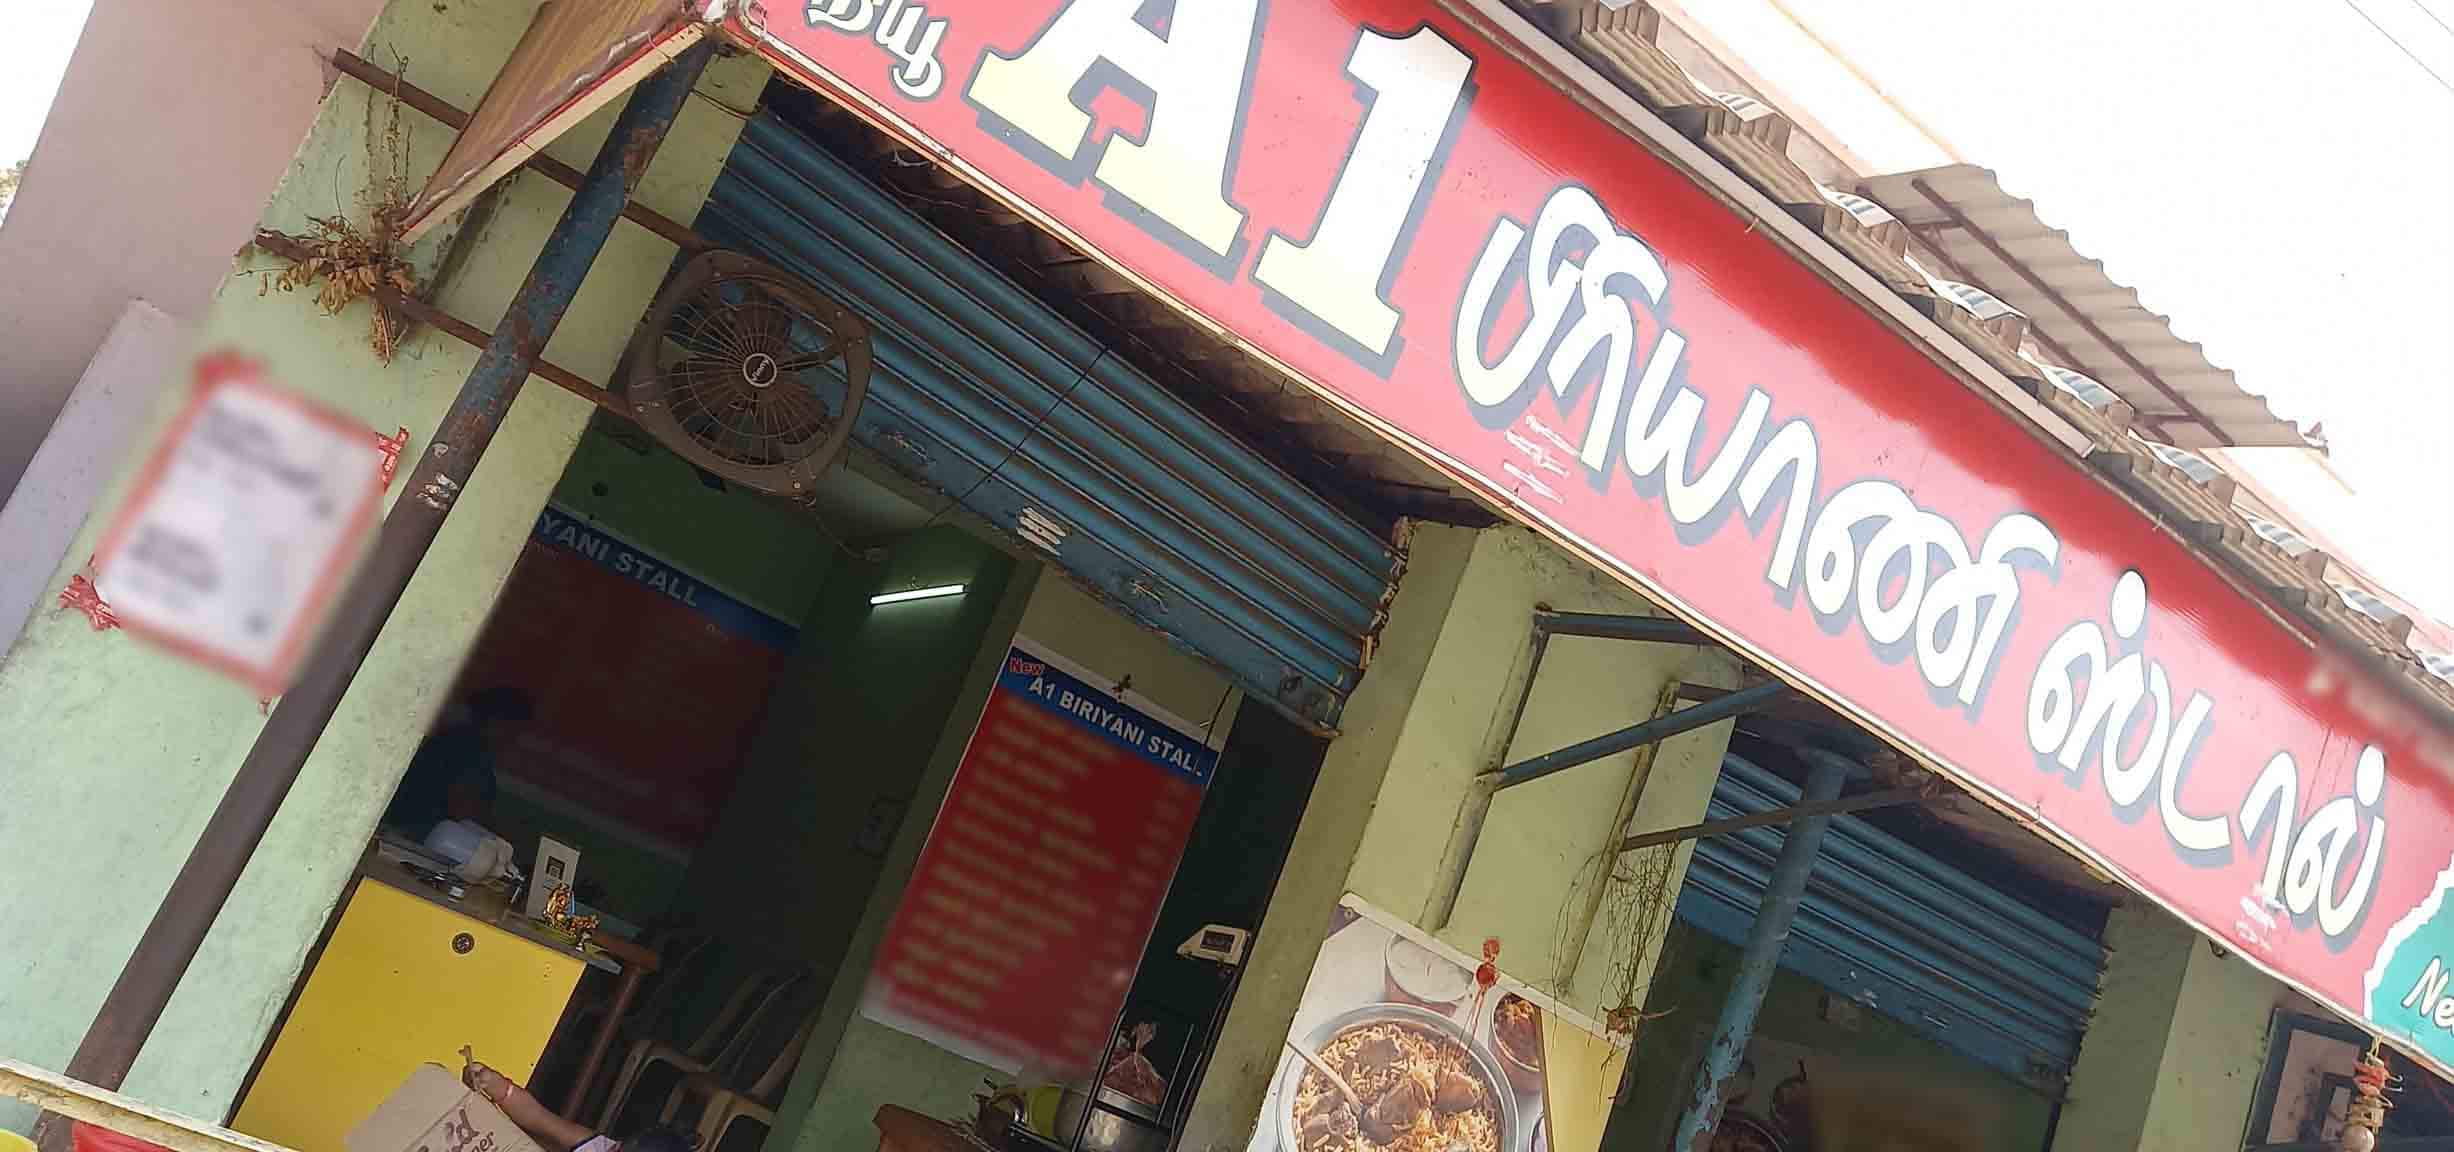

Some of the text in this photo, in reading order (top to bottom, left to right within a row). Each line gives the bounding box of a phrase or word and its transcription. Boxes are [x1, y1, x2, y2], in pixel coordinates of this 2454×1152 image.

[964, 0, 1474, 360] A1
[1455, 184, 2060, 706] பிரியாணி
[2026, 566, 2388, 938] ஸ்டால்
[537, 511, 610, 561] YANI
[614, 550, 698, 608] STALL
[1008, 656, 1045, 677] New
[1028, 676, 1057, 700] A1
[1059, 689, 1146, 746] BIRIYANI
[2401, 955, 2454, 1037] Ne
